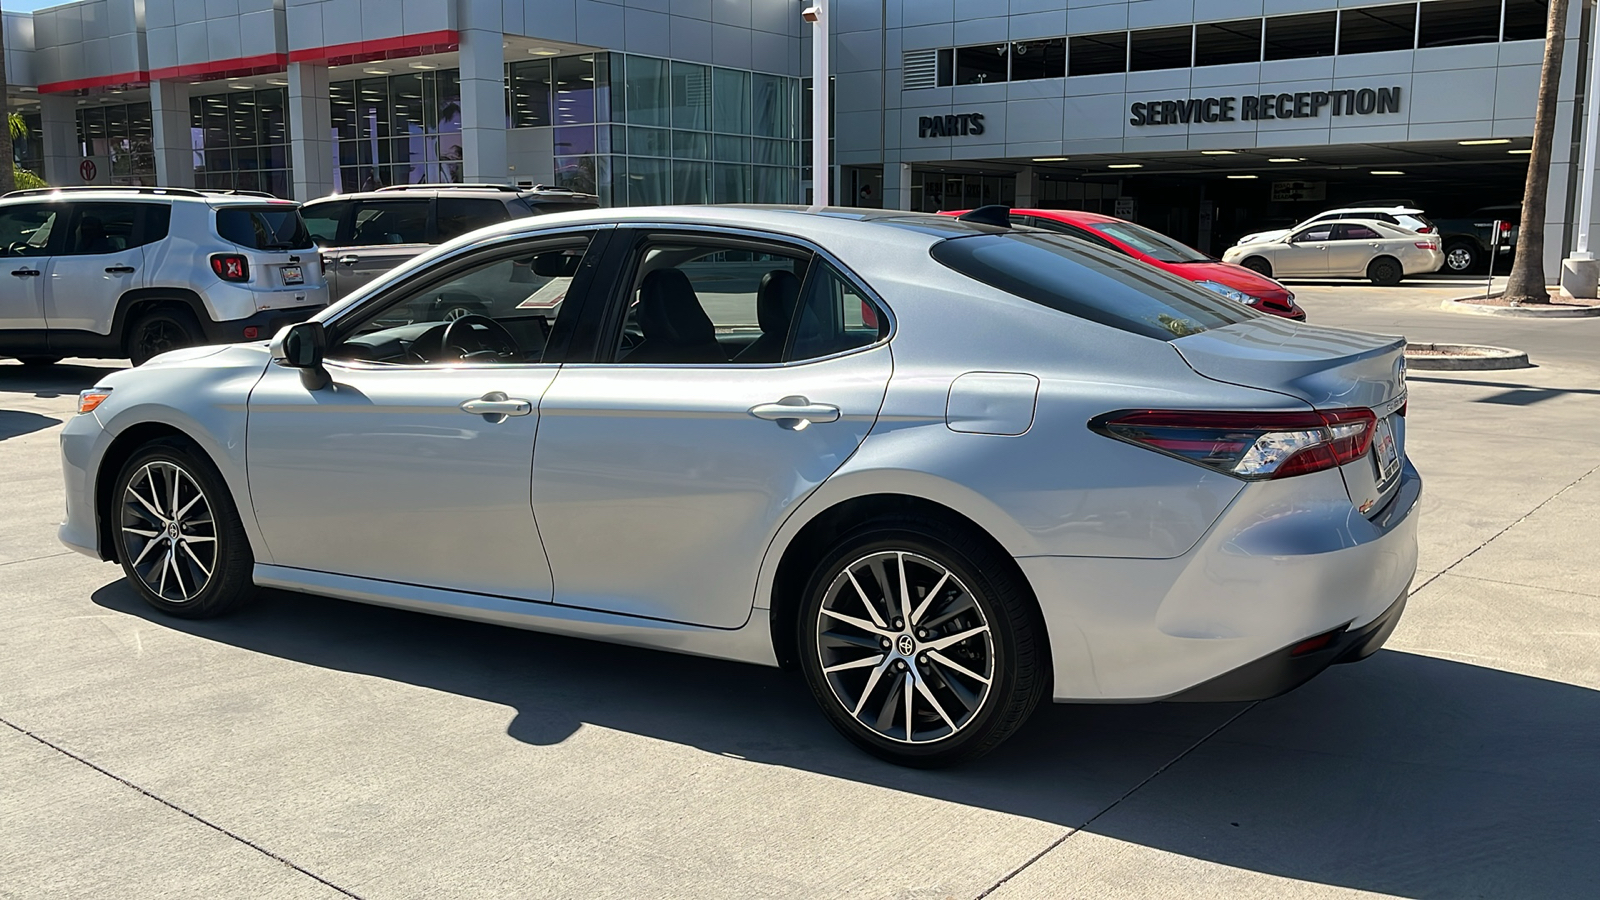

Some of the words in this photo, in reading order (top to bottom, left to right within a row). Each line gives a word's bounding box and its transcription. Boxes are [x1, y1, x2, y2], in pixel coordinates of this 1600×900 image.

[1130, 97, 1236, 126] SERVICE
[1241, 87, 1401, 121] RECEPTION
[919, 113, 984, 138] PARTS
